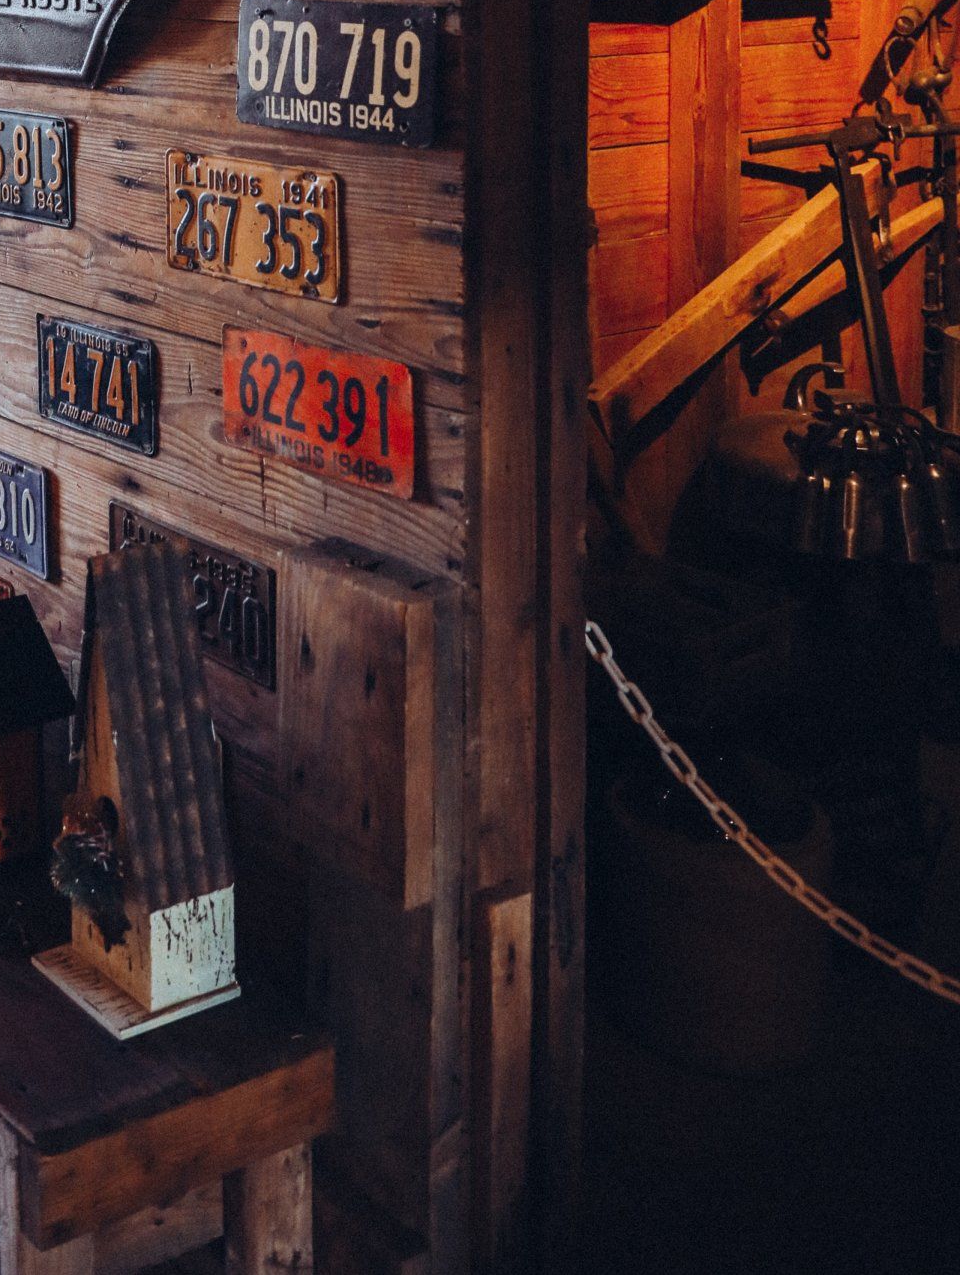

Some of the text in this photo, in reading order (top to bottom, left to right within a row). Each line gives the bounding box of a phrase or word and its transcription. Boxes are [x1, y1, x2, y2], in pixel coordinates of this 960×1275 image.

[247, 18, 422, 109] 870 719
[265, 95, 395, 132] ILLINOIS 1944
[12, 124, 63, 192] 813
[32, 188, 64, 213] 1942
[173, 163, 328, 209] ILLINOIS 1941
[174, 188, 326, 285] 267 353
[70, 327, 111, 353] ILLINOIS
[46, 336, 139, 426] 14 741
[57, 401, 131, 438] LAND OF LINCOLN
[238, 351, 389, 458] 622 391
[251, 425, 325, 469] ILLINOIS
